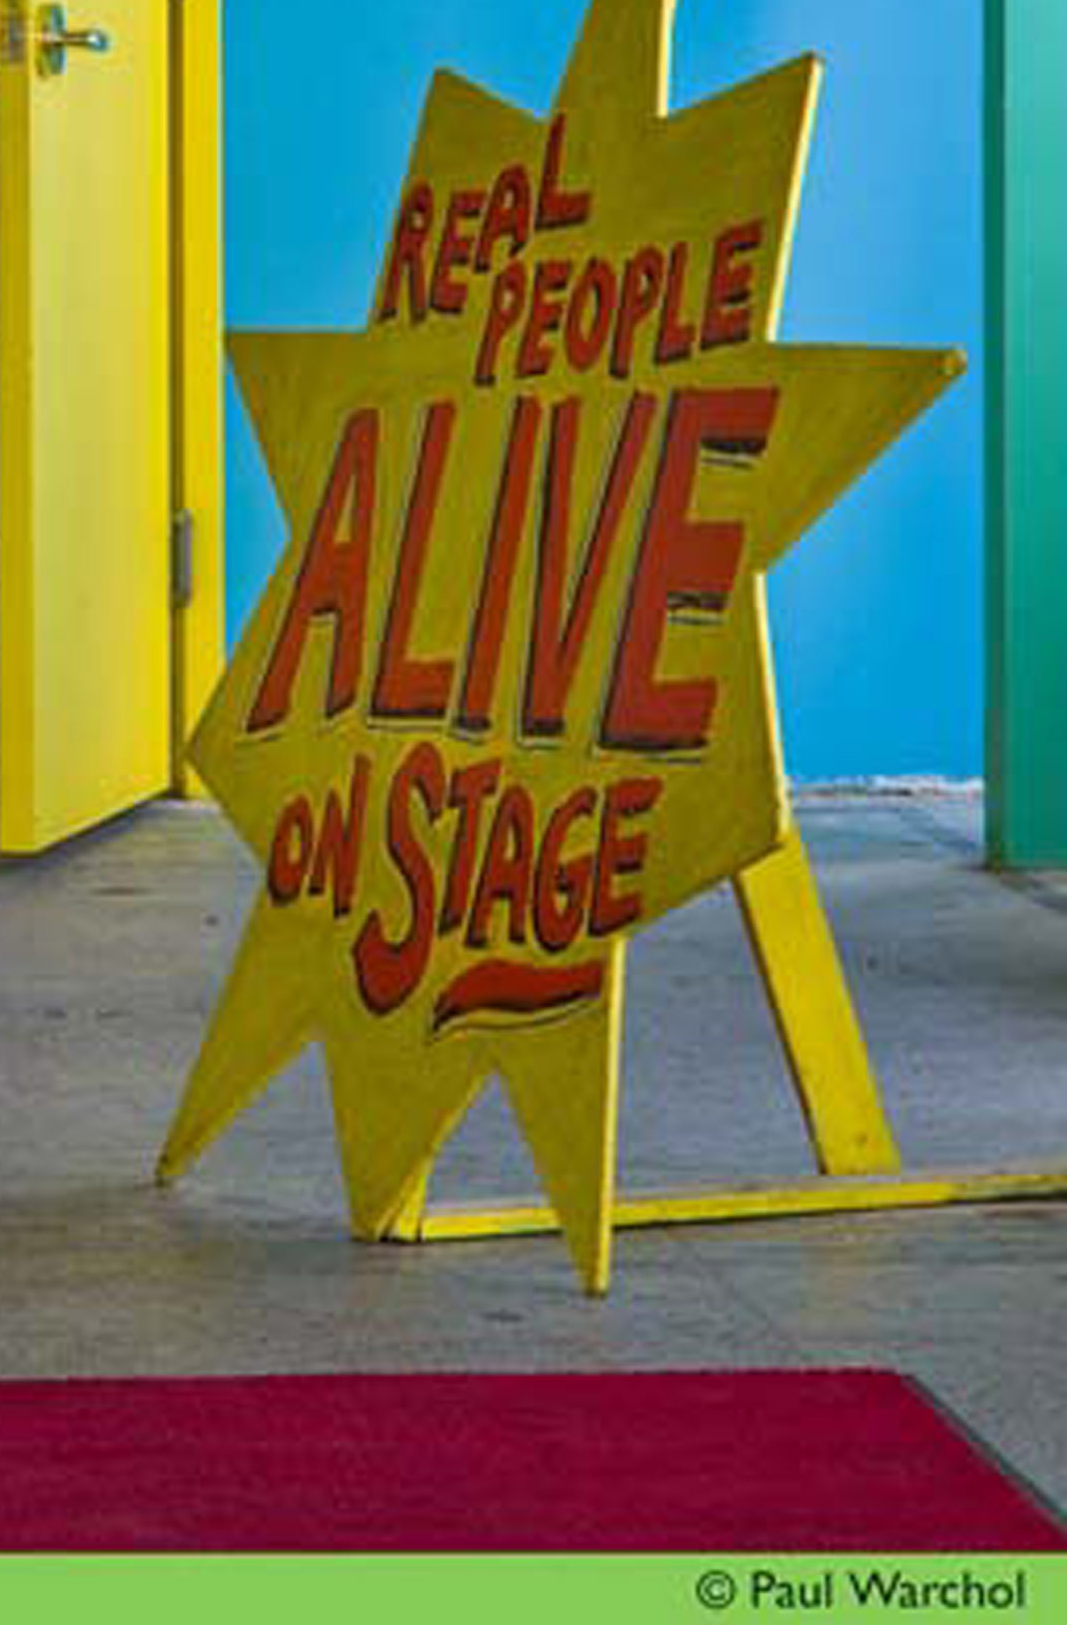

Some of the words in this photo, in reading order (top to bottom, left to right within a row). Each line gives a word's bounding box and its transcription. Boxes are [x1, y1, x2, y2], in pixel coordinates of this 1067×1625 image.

[380, 115, 592, 323] REAL
[475, 217, 764, 385] PEOPLE
[242, 385, 782, 763] ALIVE
[265, 753, 371, 919] ON
[350, 740, 666, 1017] STAGE
